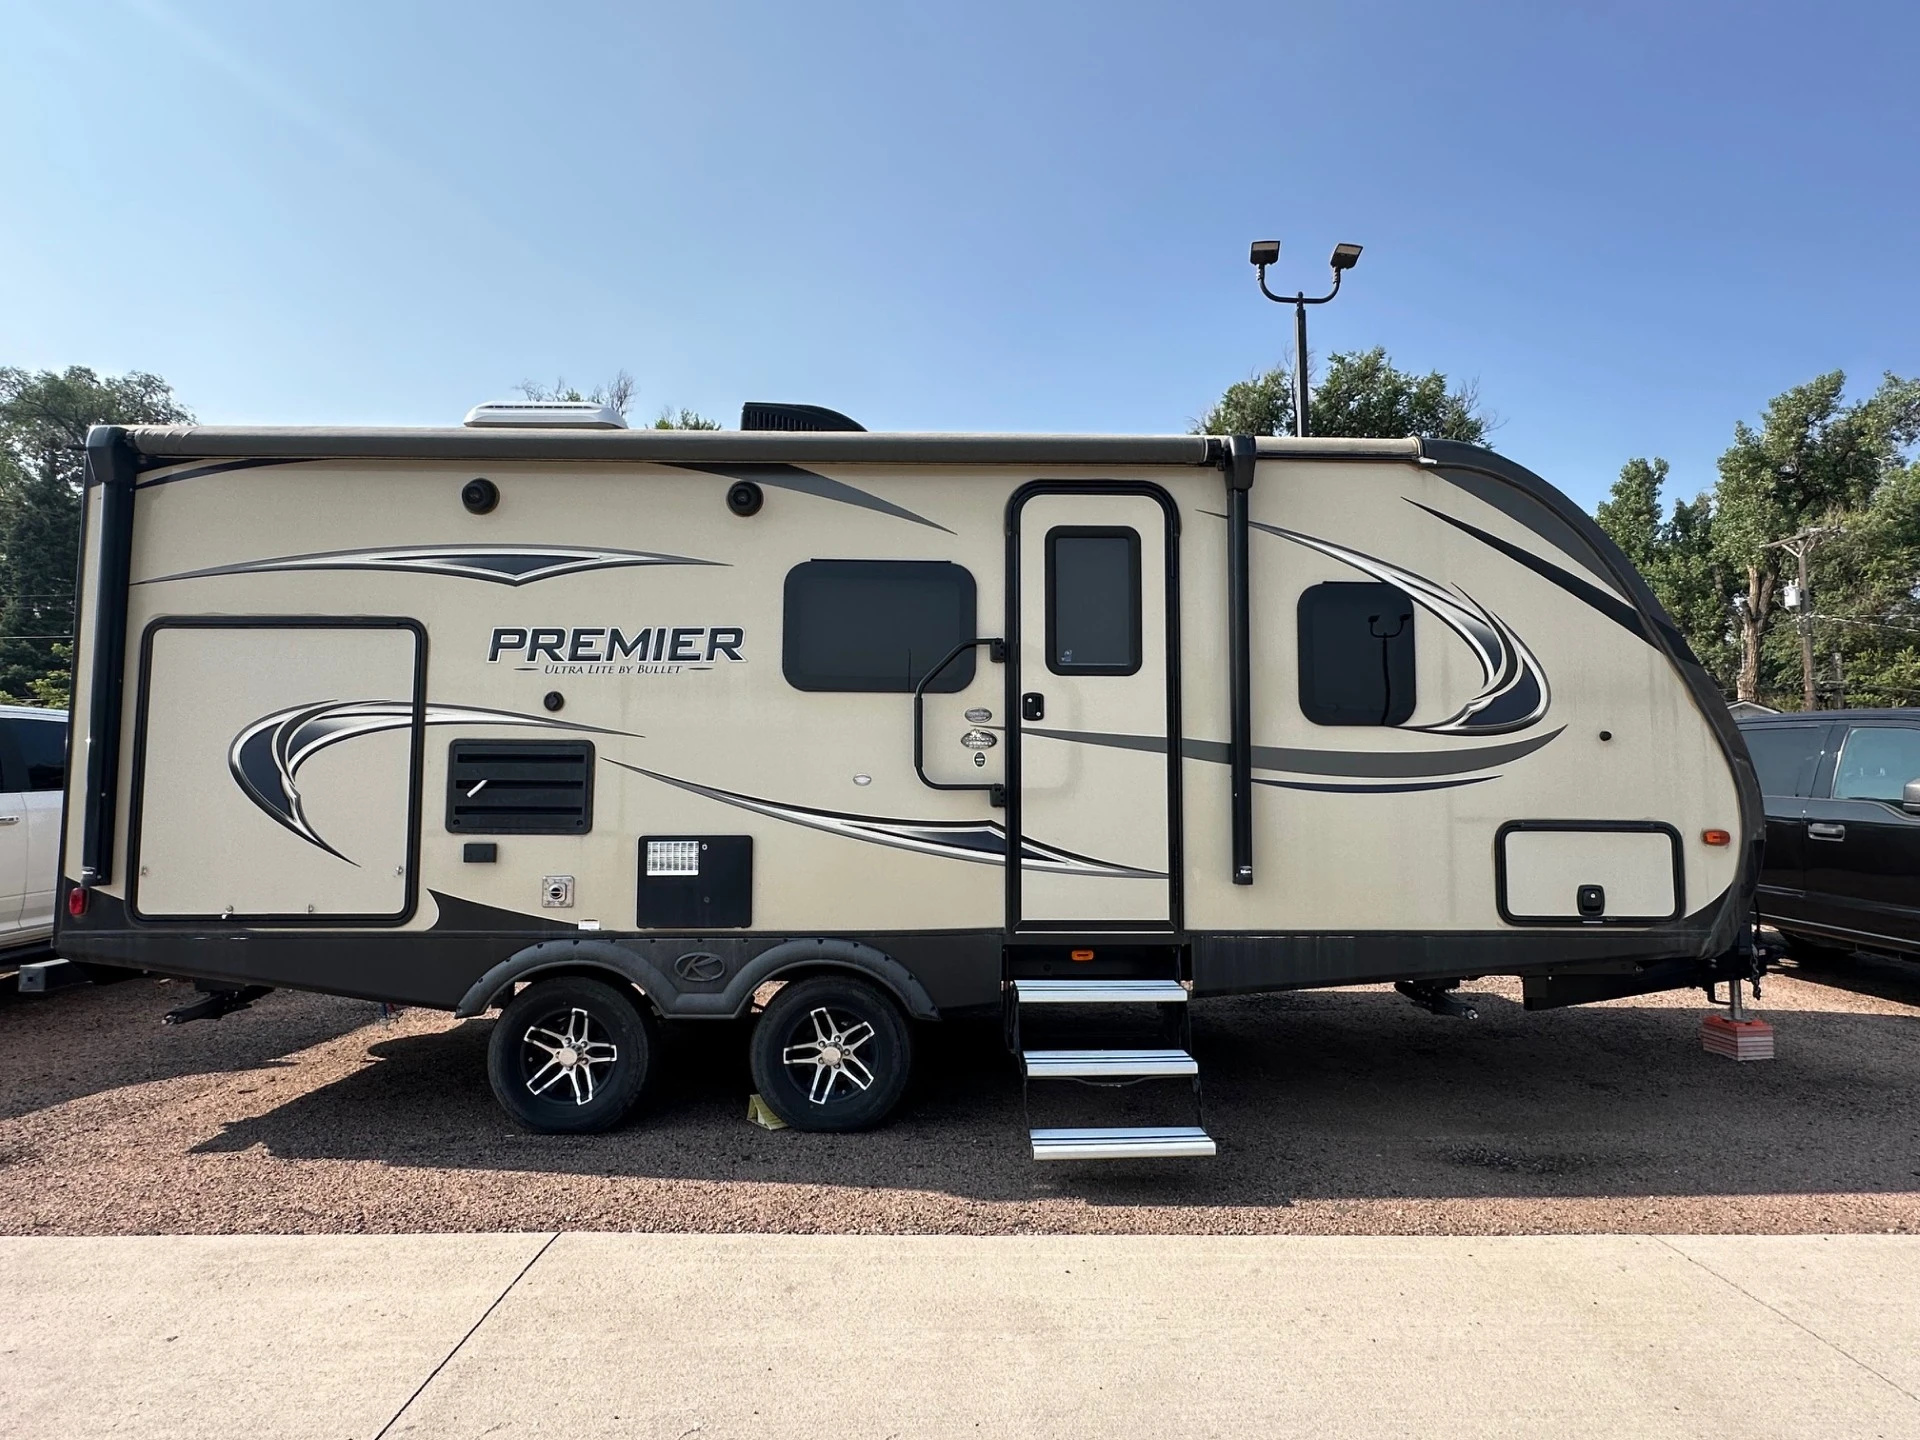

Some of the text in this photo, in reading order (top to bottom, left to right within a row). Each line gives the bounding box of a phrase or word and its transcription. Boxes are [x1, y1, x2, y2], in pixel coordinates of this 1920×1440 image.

[487, 627, 747, 663] PREMIER
[544, 664, 684, 675] ULTRA LITE BY BULLET
